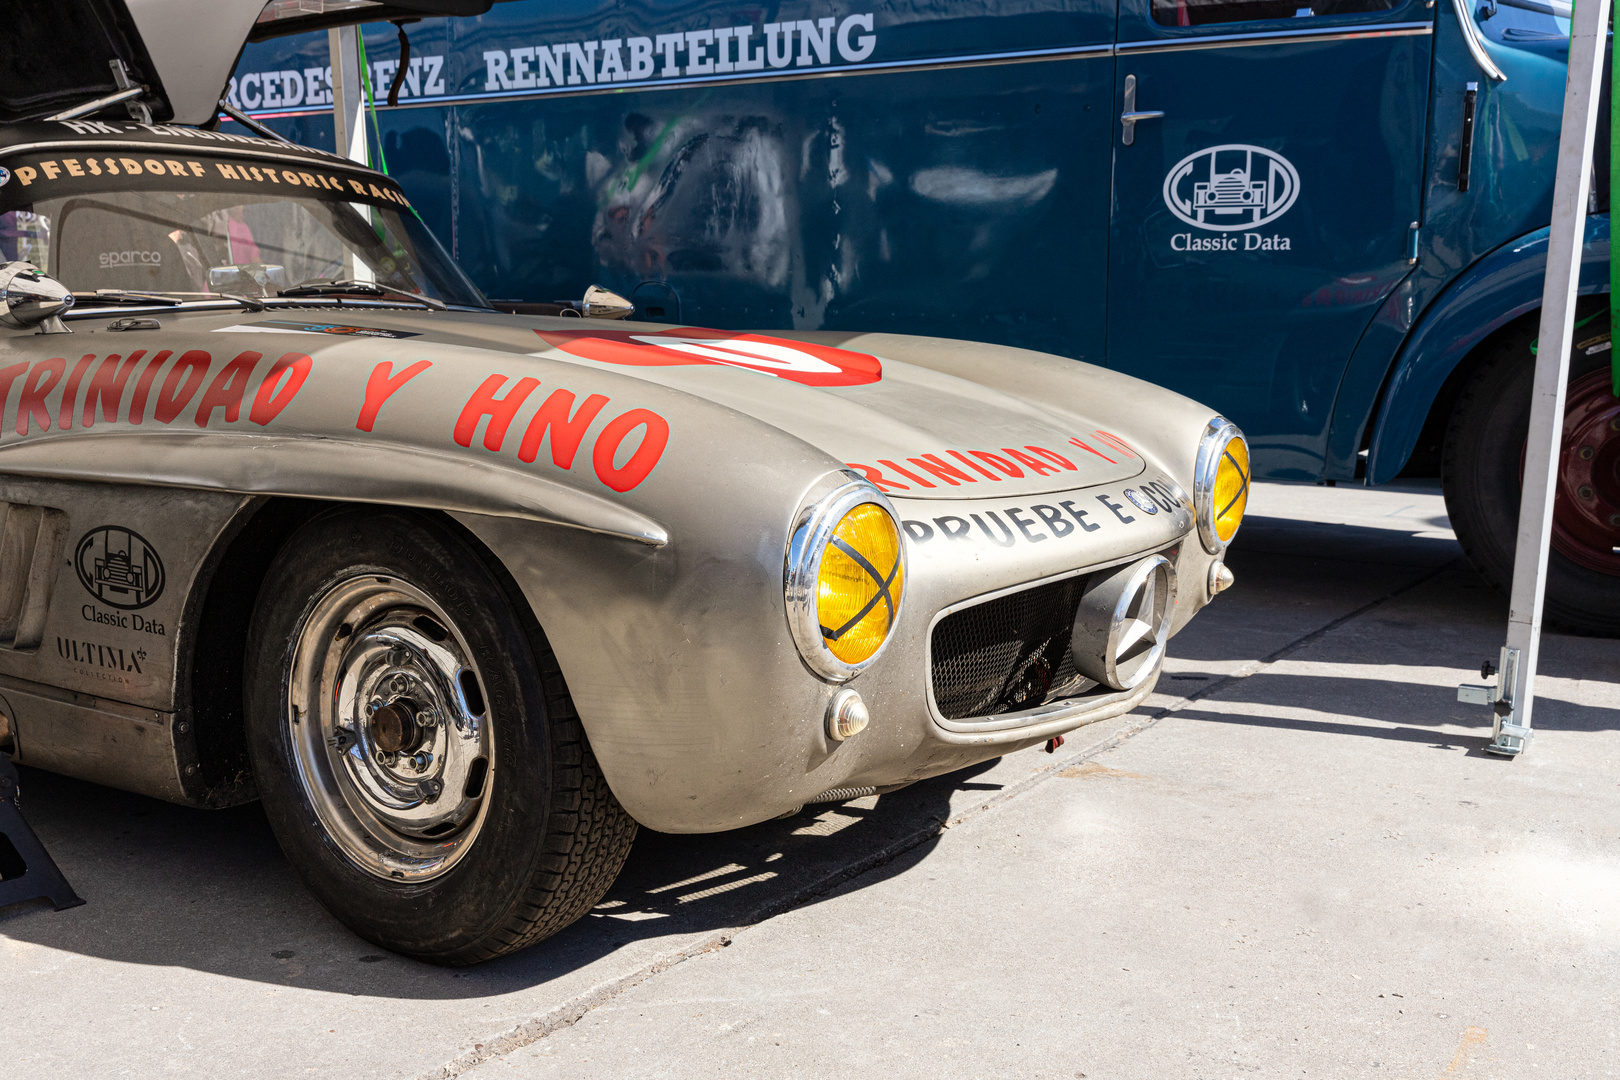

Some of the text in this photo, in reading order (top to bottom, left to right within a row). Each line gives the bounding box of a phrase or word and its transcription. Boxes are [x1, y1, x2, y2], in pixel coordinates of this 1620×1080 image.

[482, 13, 877, 91] RENNABTEILUNG
[60, 120, 124, 135] HK
[13, 157, 411, 208] PFESSDORF HISTORIC RACIN
[99, 250, 161, 268] sparco
[1170, 233, 1291, 251] Classic Data
[355, 360, 434, 433] Y
[452, 373, 670, 494] HNO
[845, 445, 1079, 493] RINIDAD
[901, 500, 1101, 548] PRUEBE
[81, 604, 166, 636] Classic Data
[57, 636, 143, 675] ULTIMA
[73, 667, 130, 684] COLLECTION
